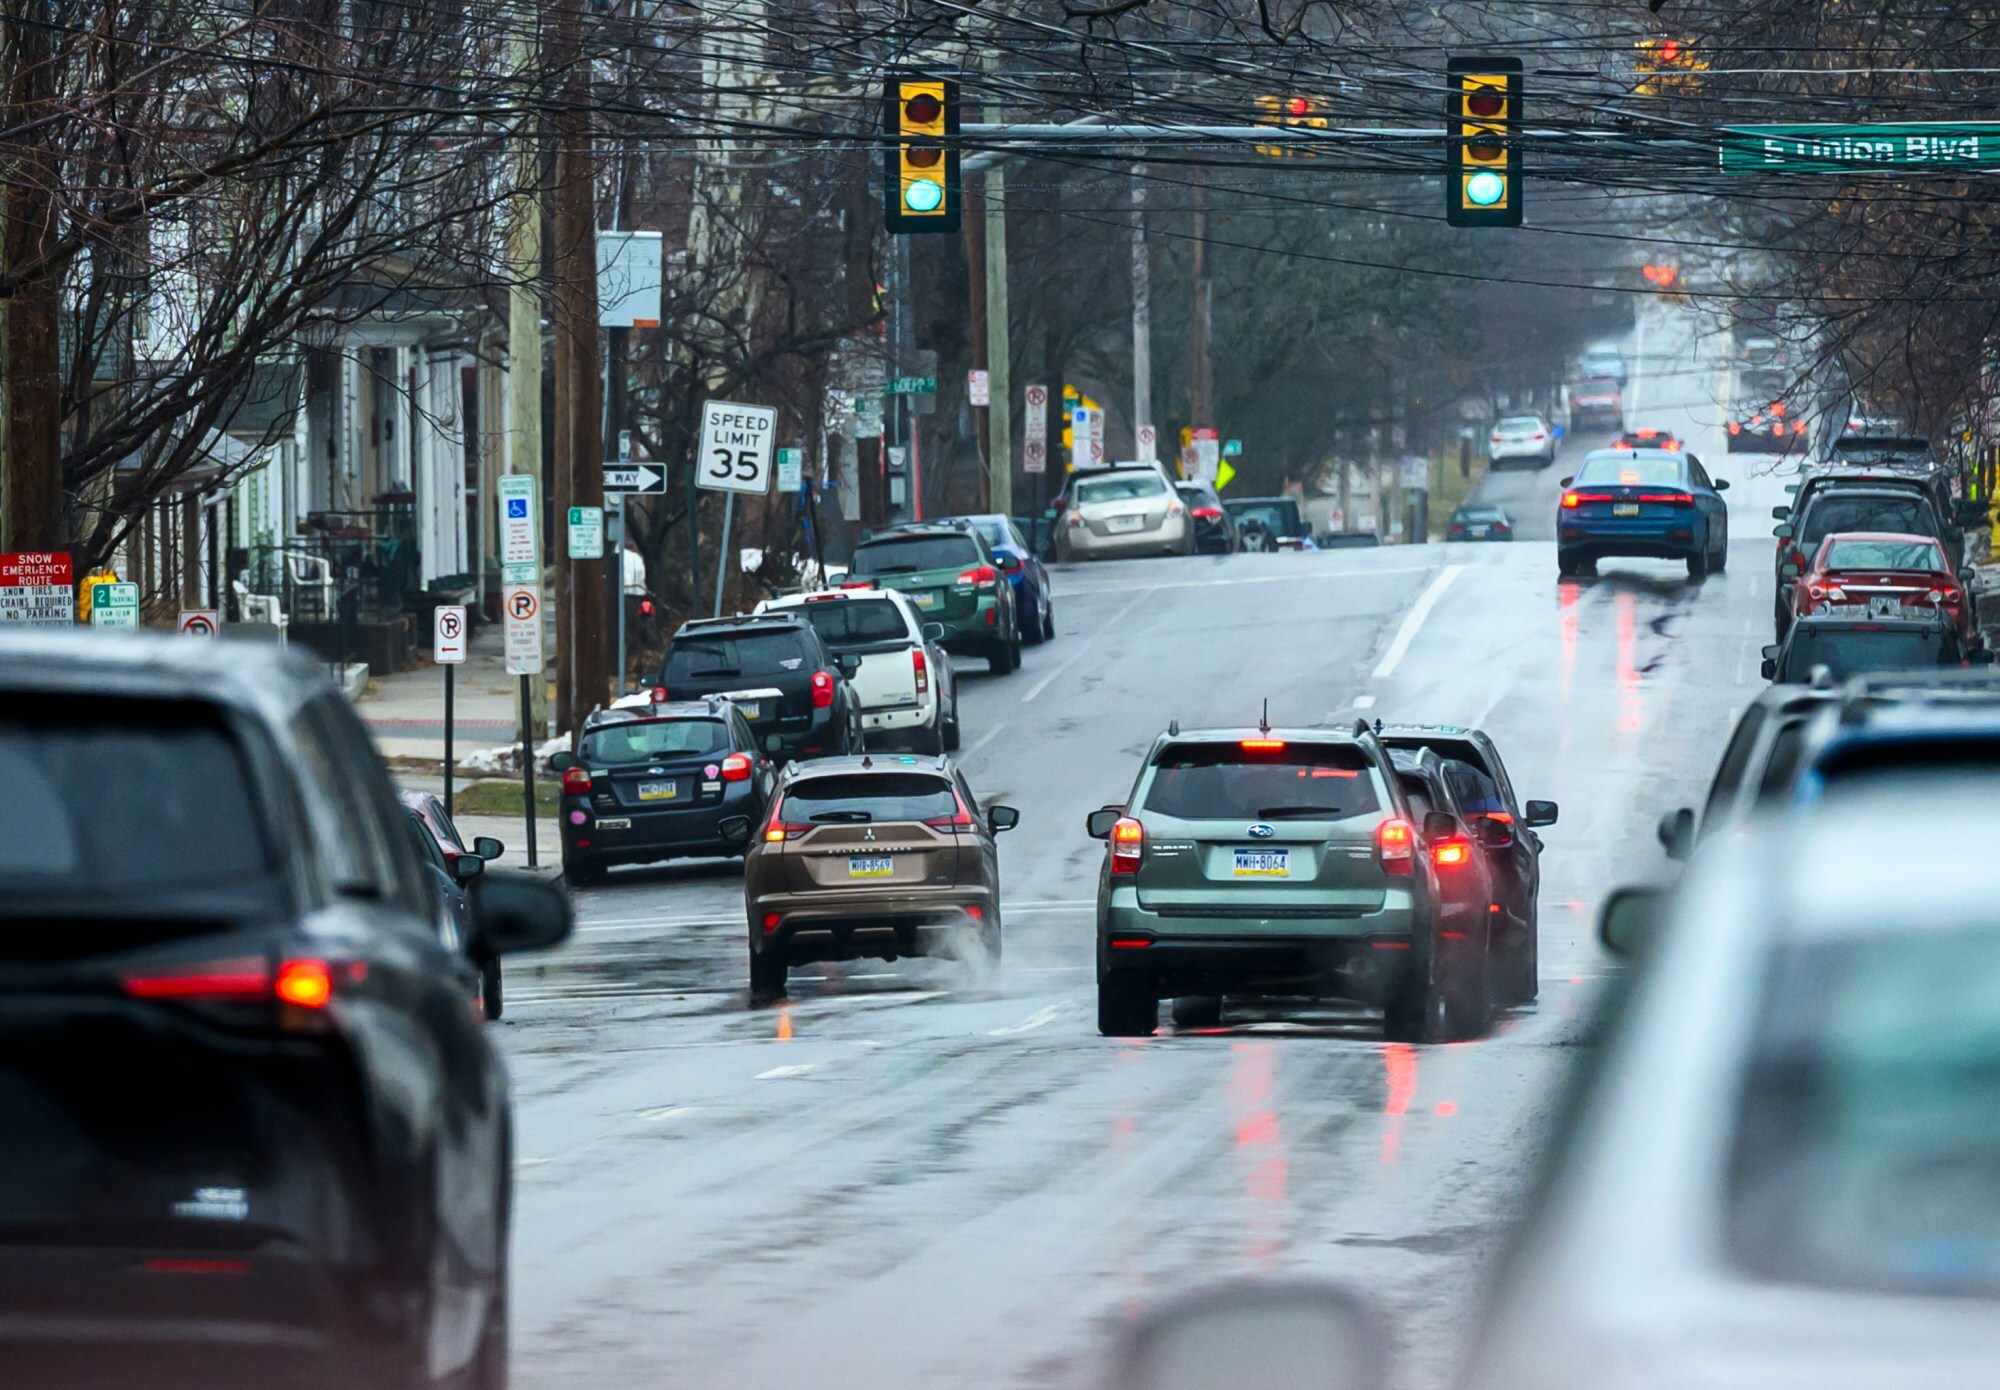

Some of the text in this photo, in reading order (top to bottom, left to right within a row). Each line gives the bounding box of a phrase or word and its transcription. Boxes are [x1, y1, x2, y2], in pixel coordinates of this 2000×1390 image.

[1764, 139, 1785, 163] E
[1906, 137, 1979, 161] Blvd
[710, 412, 769, 431] SPEED
[714, 430, 761, 447] LIMIT
[709, 448, 759, 481] 35
[614, 473, 638, 483] WAY
[18, 554, 52, 564] SNOW
[2, 564, 67, 576] EMERGENCY
[18, 576, 53, 586] ROUTE
[3, 585, 69, 596] SNOW TIRES OR
[98, 590, 106, 603] 2
[0, 596, 73, 608] CHAINS REQUIRED
[6, 608, 67, 620] NO PARKING
